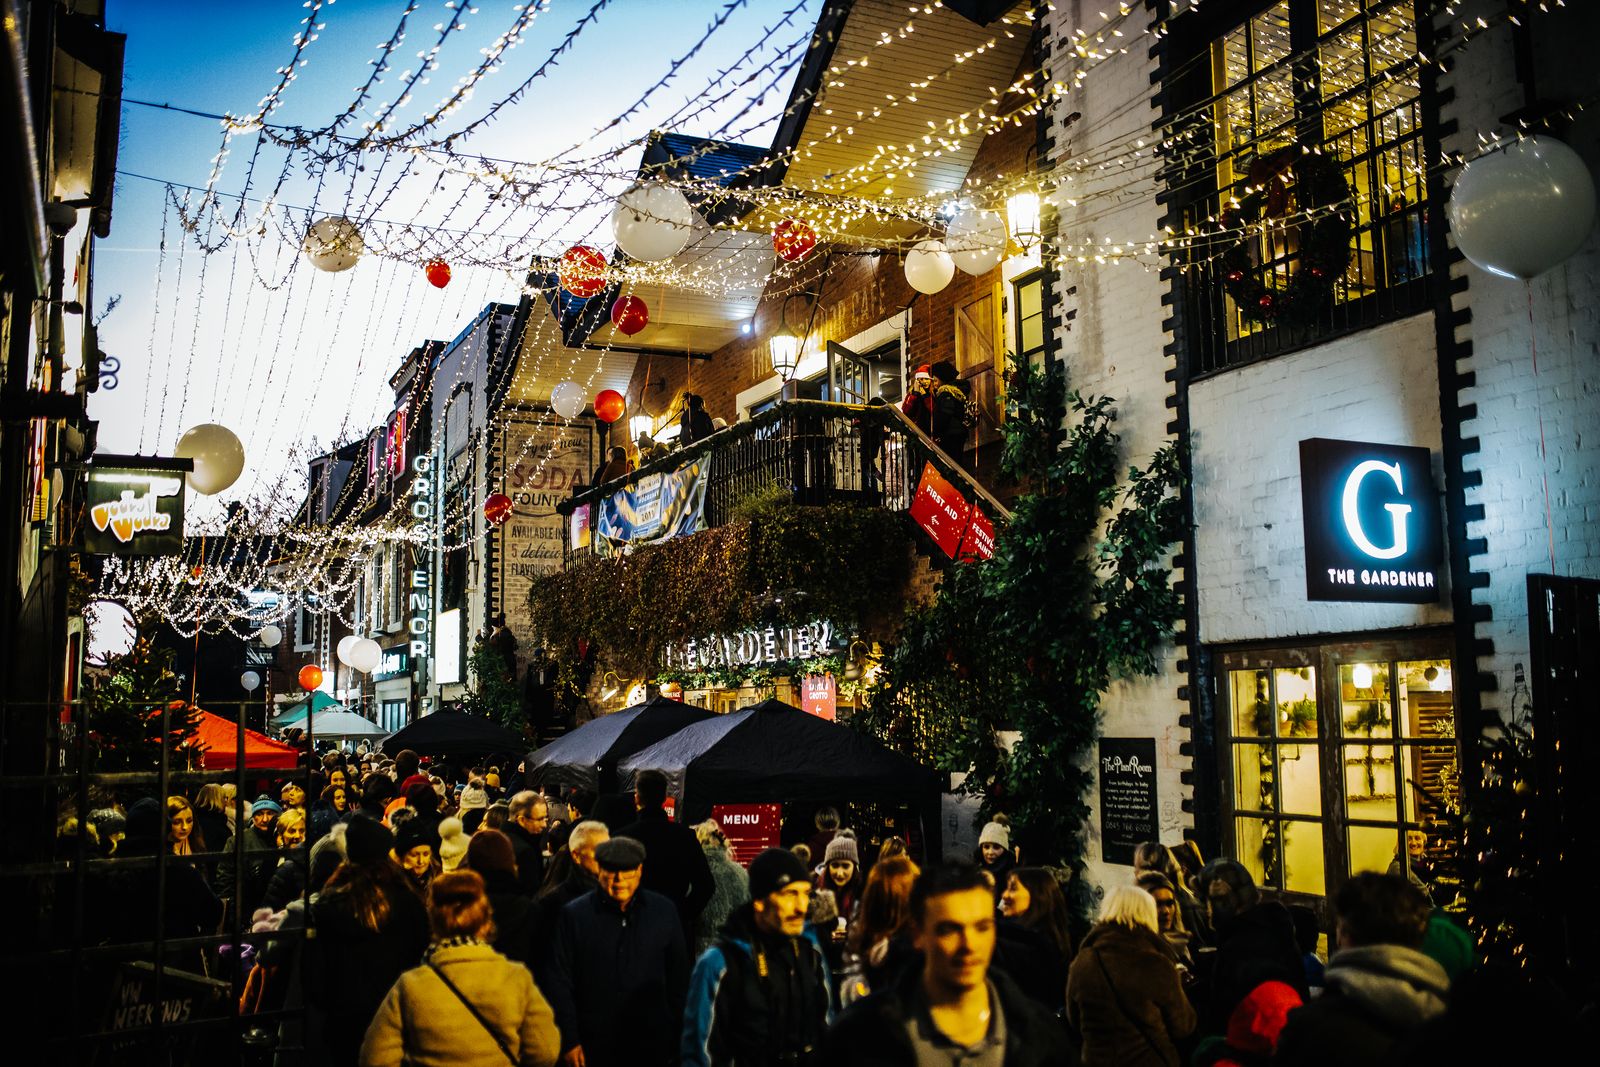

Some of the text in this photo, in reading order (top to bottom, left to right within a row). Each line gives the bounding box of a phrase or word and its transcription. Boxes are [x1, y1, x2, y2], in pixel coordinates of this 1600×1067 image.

[560, 437, 582, 449] new
[512, 464, 584, 491] SODA
[926, 484, 958, 521] FIRST AID
[1342, 459, 1412, 560] G
[511, 525, 554, 540] AVAILABLE
[972, 522, 994, 549] FESTIVE
[410, 455, 430, 658] GROSVENOR
[511, 541, 562, 560] 5 delicio
[1328, 568, 1434, 588] THE GARDENER
[808, 691, 829, 700] GROTTO
[1102, 755, 1152, 778] The Plant Room
[723, 814, 760, 825] MENU
[113, 998, 192, 1031] WEEKNDS
